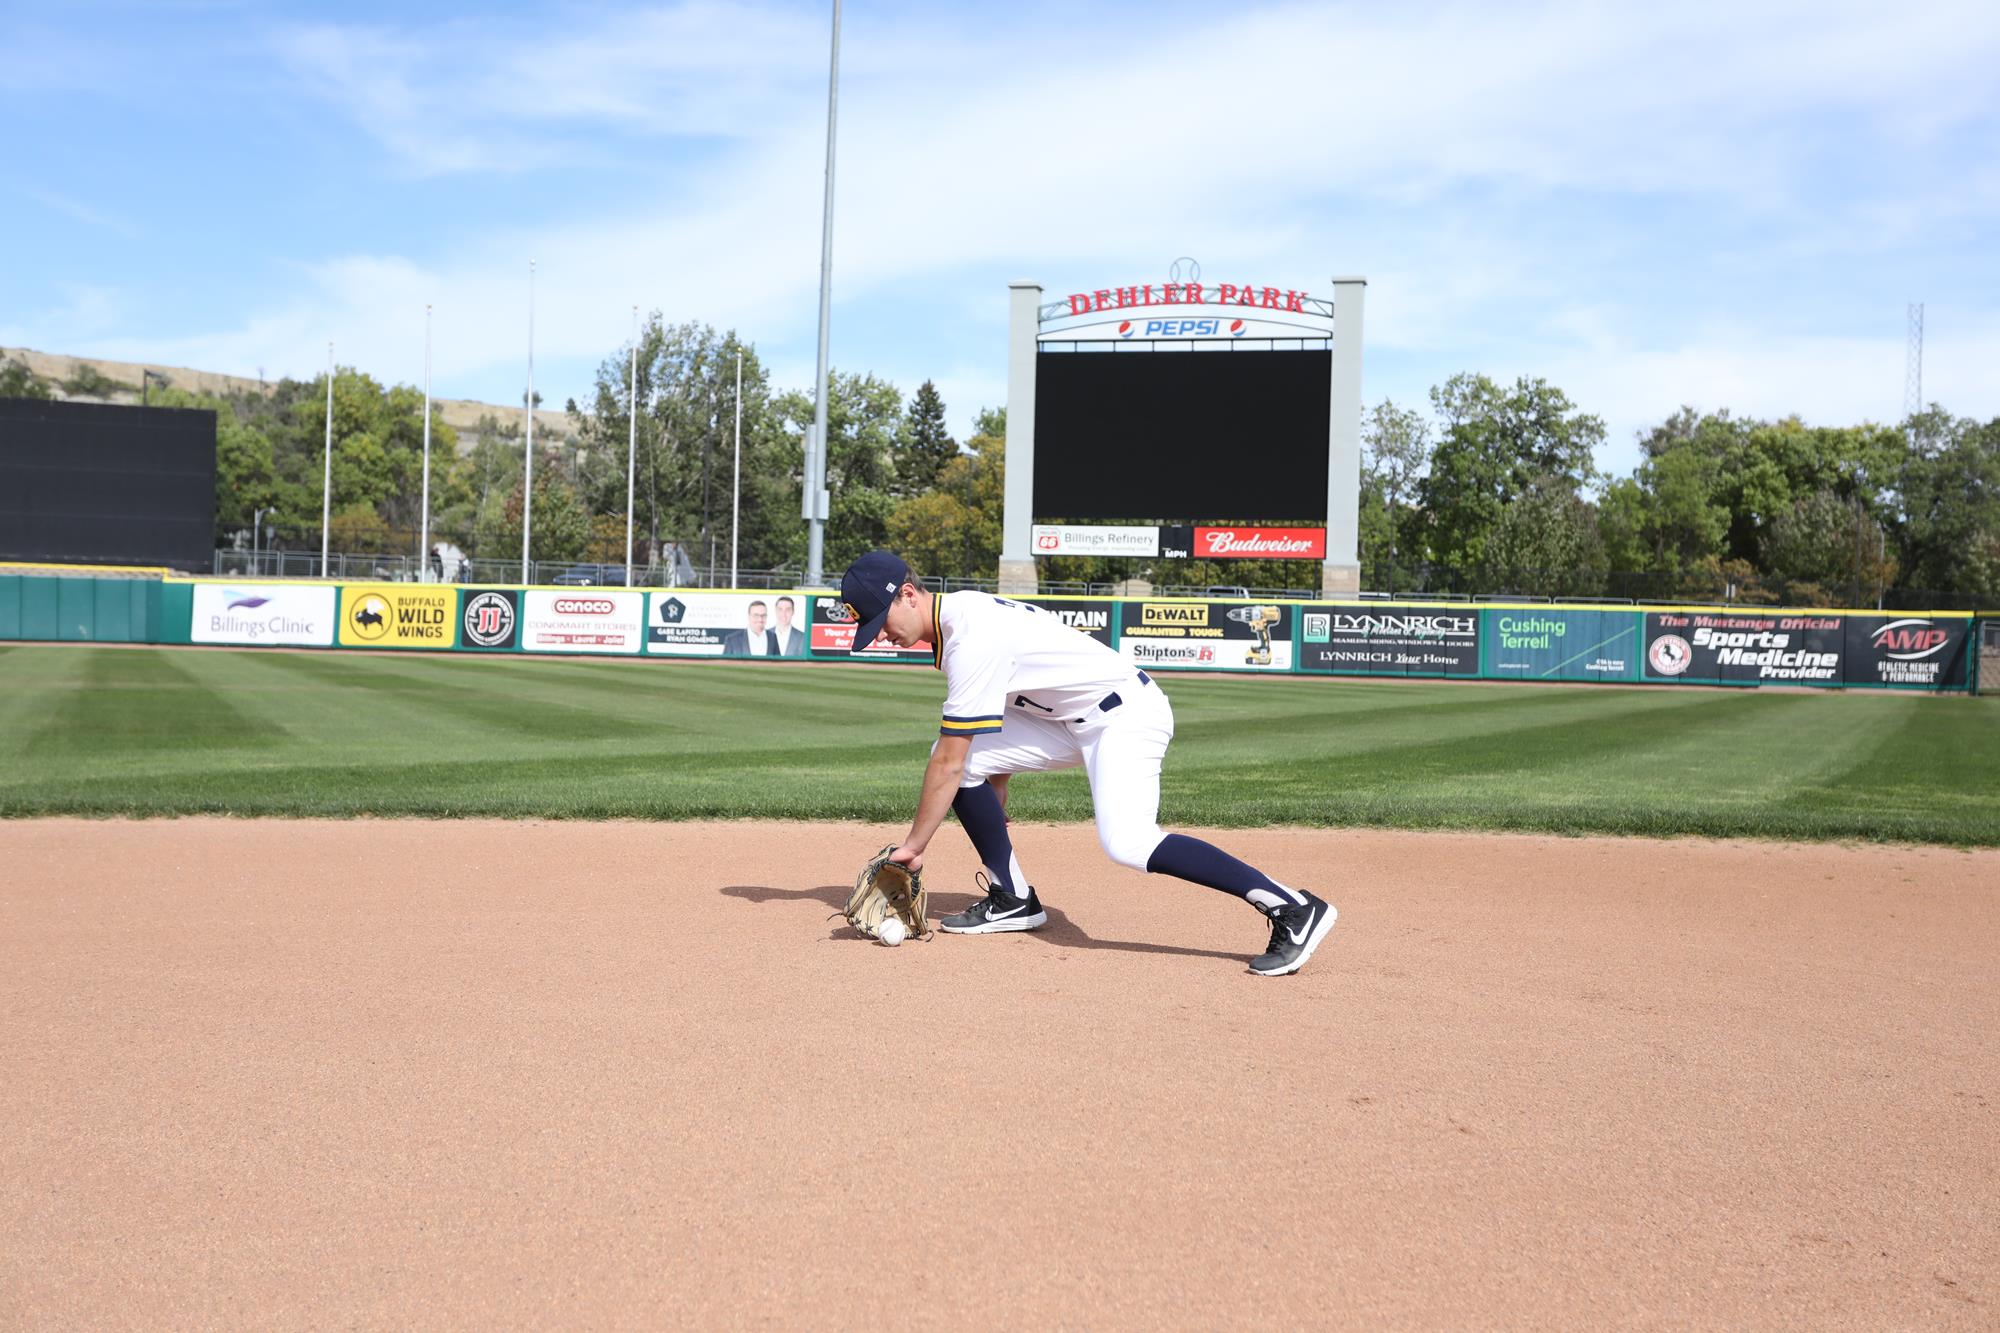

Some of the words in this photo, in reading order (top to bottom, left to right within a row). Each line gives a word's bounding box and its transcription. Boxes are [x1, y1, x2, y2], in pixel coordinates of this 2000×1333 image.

[1068, 283, 1205, 315] DEHLER
[1218, 283, 1309, 314] PARK
[1145, 320, 1220, 336] PEPSI
[1039, 537, 1058, 547] 66
[1065, 533, 1105, 545] Billings
[1108, 533, 1154, 546] Refinery
[1206, 531, 1313, 553] Budweiser
[1165, 550, 1187, 559] MPH
[397, 597, 446, 607] BUFFALO
[398, 609, 445, 624] WILD
[478, 607, 501, 634] JJ
[1333, 614, 1476, 632] LYNNRICH
[1659, 615, 1690, 627] The
[1693, 616, 1776, 631] Mustangs
[1780, 618, 1841, 630] Official
[211, 615, 265, 638] Billings
[268, 617, 315, 634] Clinic
[397, 626, 443, 638] WINGS
[528, 621, 590, 630] CONOMART
[594, 622, 637, 631] STORES
[824, 628, 847, 637] Your
[1126, 627, 1185, 636] GUARANTEED
[1499, 617, 1566, 637] Cushing
[1693, 628, 1790, 650] Sports
[1873, 630, 1947, 649] AMP
[1133, 644, 1195, 662] Shipton's
[1320, 652, 1391, 662] LYNNRICH
[1395, 653, 1421, 664] Your
[1424, 654, 1459, 665] Home
[1717, 648, 1839, 666] Medicine
[1760, 666, 1837, 679] Provider
[1878, 661, 1908, 672] ATHLETIC
[1909, 662, 1940, 673] MEDICINE
[1889, 672, 1935, 683] PERFORMANCE
